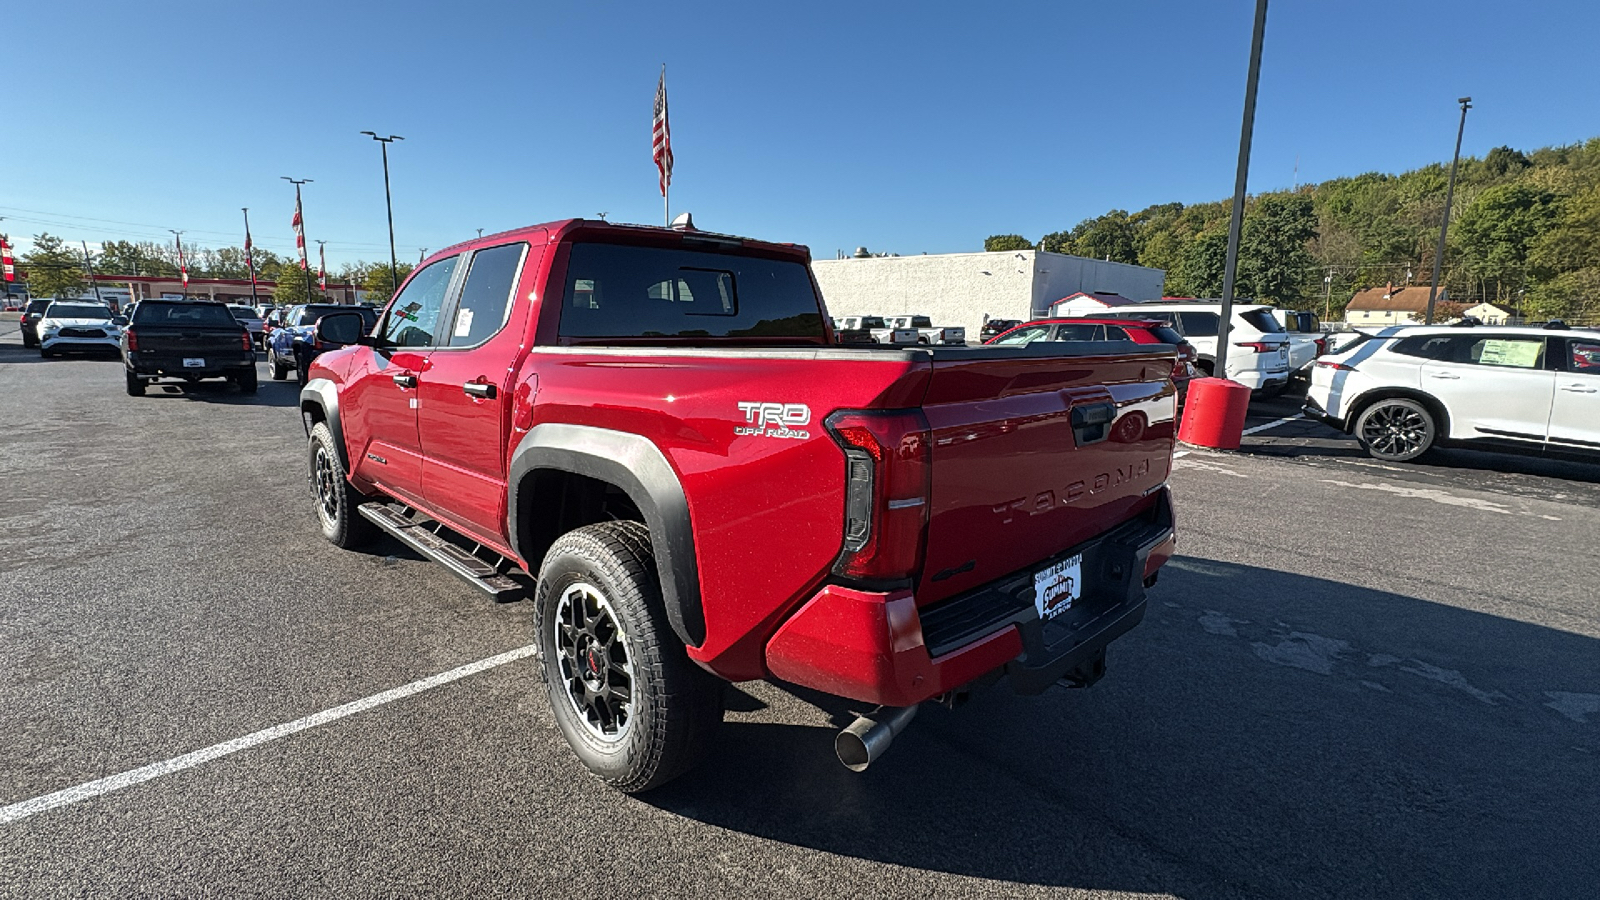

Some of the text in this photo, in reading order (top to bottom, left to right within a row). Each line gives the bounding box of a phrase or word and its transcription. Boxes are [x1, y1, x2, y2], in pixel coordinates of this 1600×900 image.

[737, 401, 811, 428] TRD
[734, 426, 810, 440] OFF ROAD
[992, 458, 1149, 523] TACOMA
[1045, 578, 1072, 608] SUMMIT
